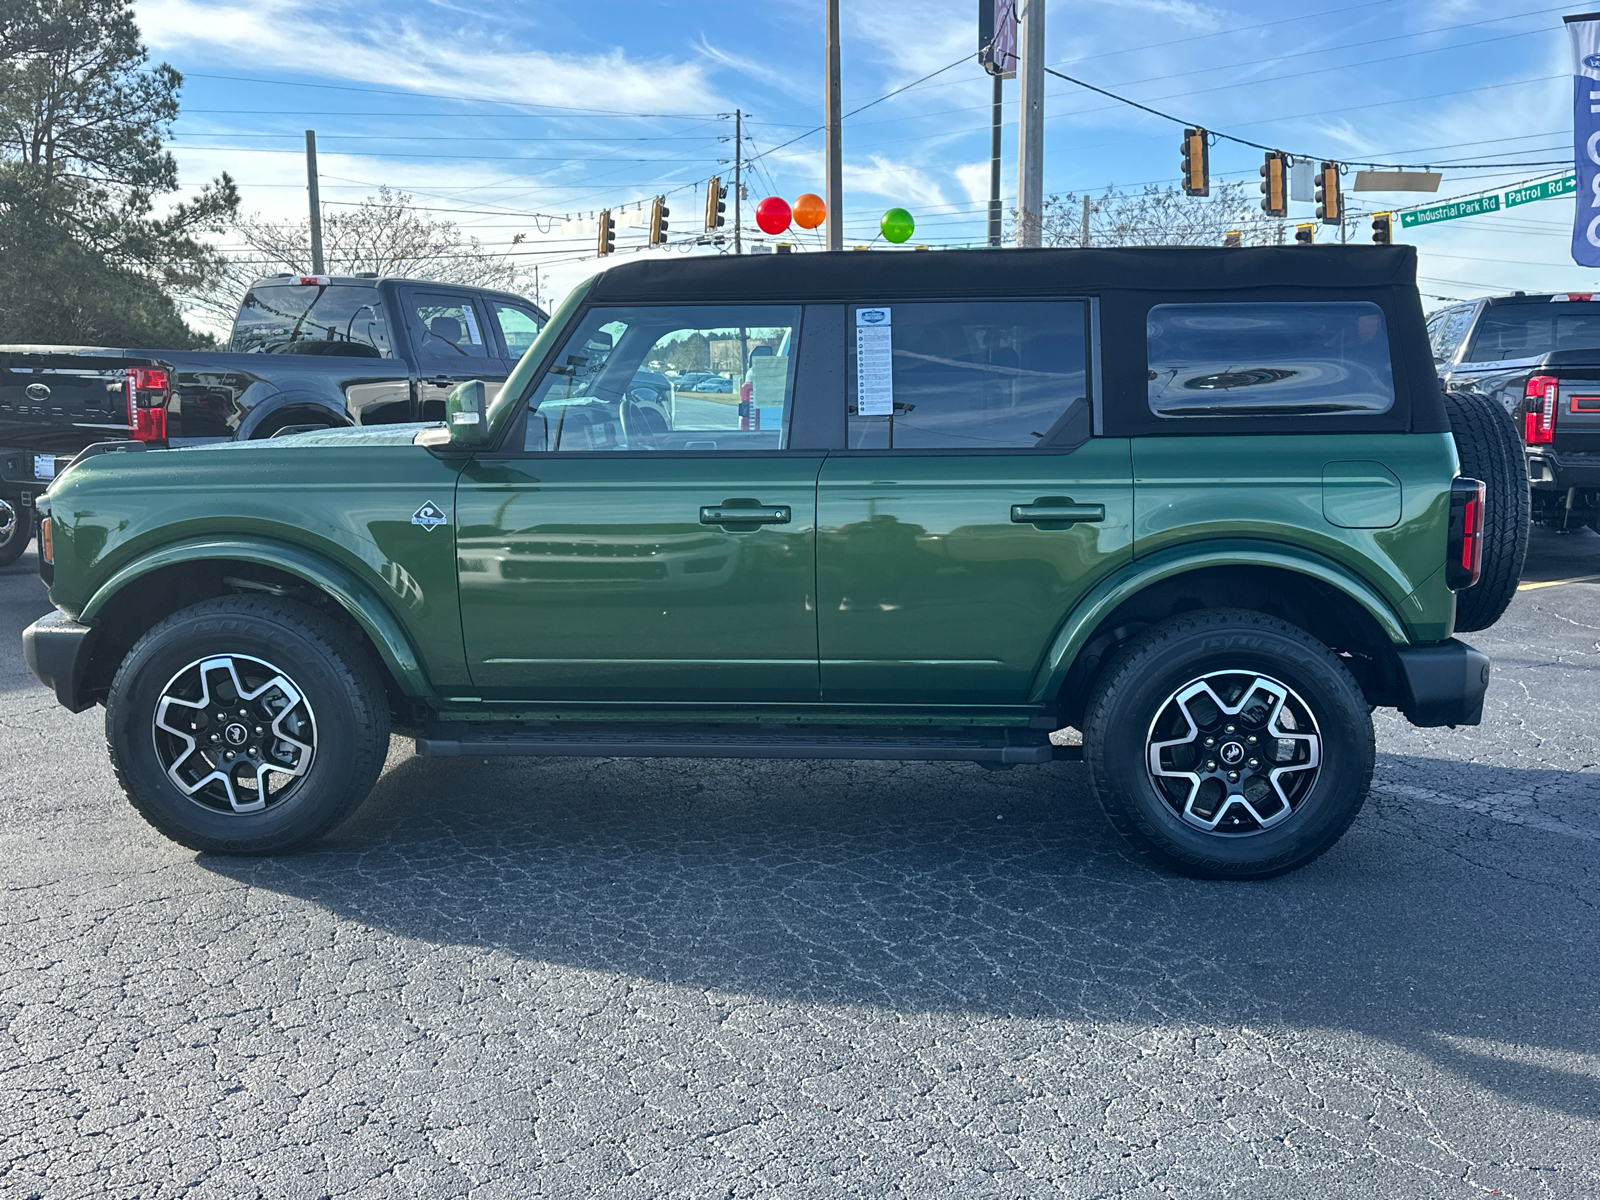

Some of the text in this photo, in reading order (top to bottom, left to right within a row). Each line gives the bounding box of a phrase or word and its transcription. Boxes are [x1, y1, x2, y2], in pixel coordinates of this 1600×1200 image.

[1509, 180, 1564, 204] Patrol Rd
[1418, 197, 1496, 222] Industrial Park Rd
